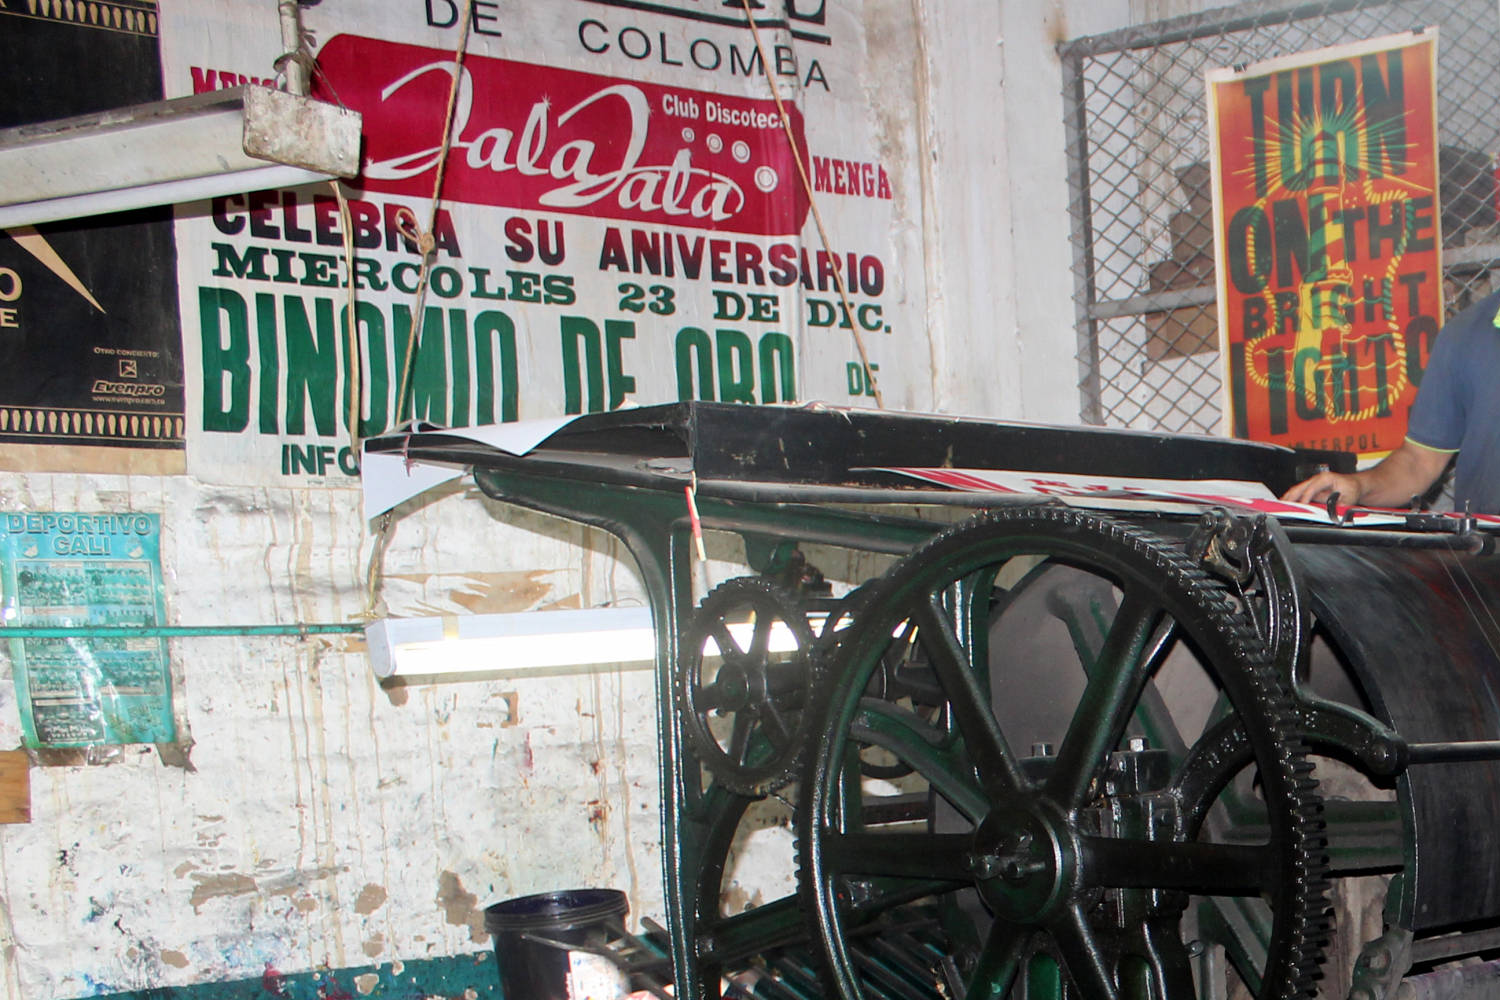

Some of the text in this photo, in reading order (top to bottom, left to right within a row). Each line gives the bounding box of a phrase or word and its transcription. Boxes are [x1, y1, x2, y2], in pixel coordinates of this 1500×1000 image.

[662, 94, 699, 119] Club
[1243, 50, 1408, 196] TURN
[812, 156, 892, 200] MENGA
[211, 190, 885, 297] CELEBRA SU ANIVERSARIO
[1334, 195, 1435, 266] THE
[211, 242, 576, 307] MIERCOLES
[618, 283, 677, 317] 23
[712, 290, 780, 324] DE
[1242, 270, 1427, 335] BRIGHT
[92, 380, 165, 396] Evenpro
[198, 285, 520, 438] BINOMIO
[560, 315, 637, 416] DE
[845, 362, 880, 397] DE
[7, 514, 152, 535] DEPORTIVO
[53, 535, 111, 555] CALI
